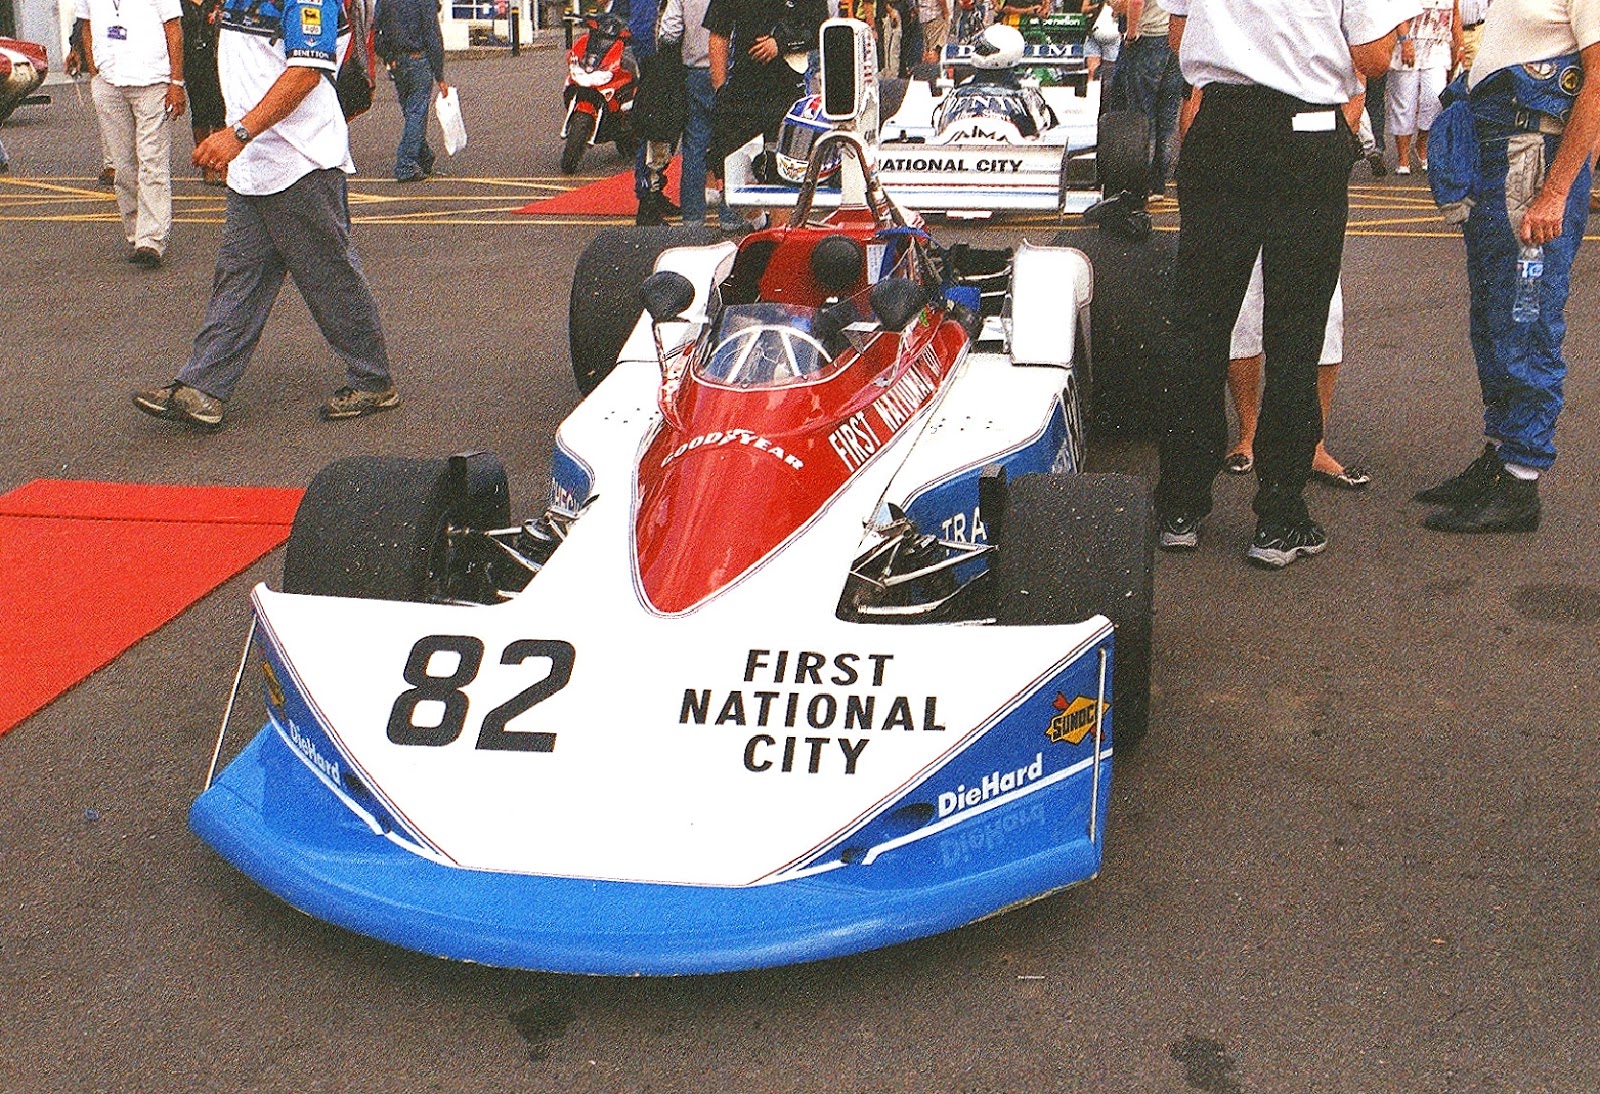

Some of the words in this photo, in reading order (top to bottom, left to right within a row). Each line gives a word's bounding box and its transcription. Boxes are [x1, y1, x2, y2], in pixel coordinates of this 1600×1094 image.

[293, 49, 329, 59] BENETTON
[958, 45, 1073, 57] DIM
[878, 158, 969, 171] ATIONAL
[976, 158, 1023, 172] CITY
[660, 429, 804, 470] GOODYEAR
[828, 411, 881, 472] FIRST
[744, 650, 894, 687] FIRST
[386, 635, 576, 752] 82
[679, 689, 946, 731] NATIONAL
[289, 720, 341, 785] DieHard
[743, 734, 869, 775] CITY
[938, 752, 1043, 818] DieHard
